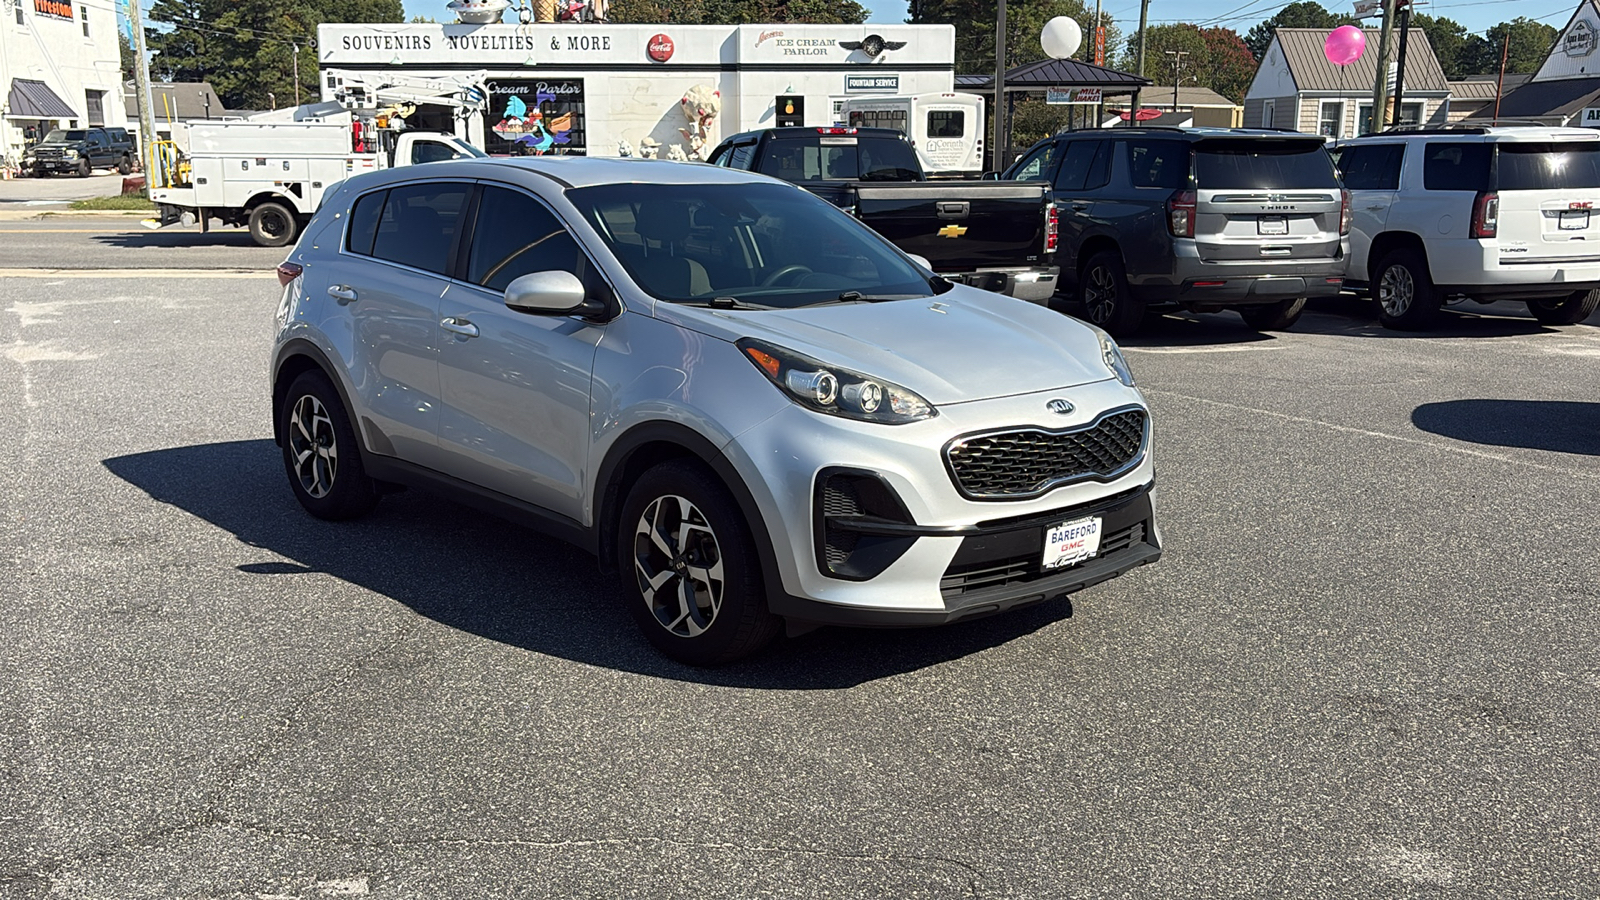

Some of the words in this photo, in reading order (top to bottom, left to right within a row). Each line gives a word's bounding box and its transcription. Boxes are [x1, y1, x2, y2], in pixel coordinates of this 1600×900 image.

[34, 0, 73, 18] Firestone
[342, 35, 431, 50] SOUVENIRS
[449, 35, 533, 50] NOVELTIES
[550, 36, 560, 50] &
[567, 36, 611, 50] MORE
[784, 48, 828, 56] PARLOR
[487, 82, 530, 94] Cream
[536, 81, 581, 95] Parlor
[849, 78, 875, 88] FOUNTAIN
[875, 78, 897, 88] SERVICE
[936, 140, 963, 148] Corinth
[1050, 400, 1073, 412] KIA
[1051, 523, 1097, 544] BAREFORD
[1060, 539, 1086, 552] GMC
